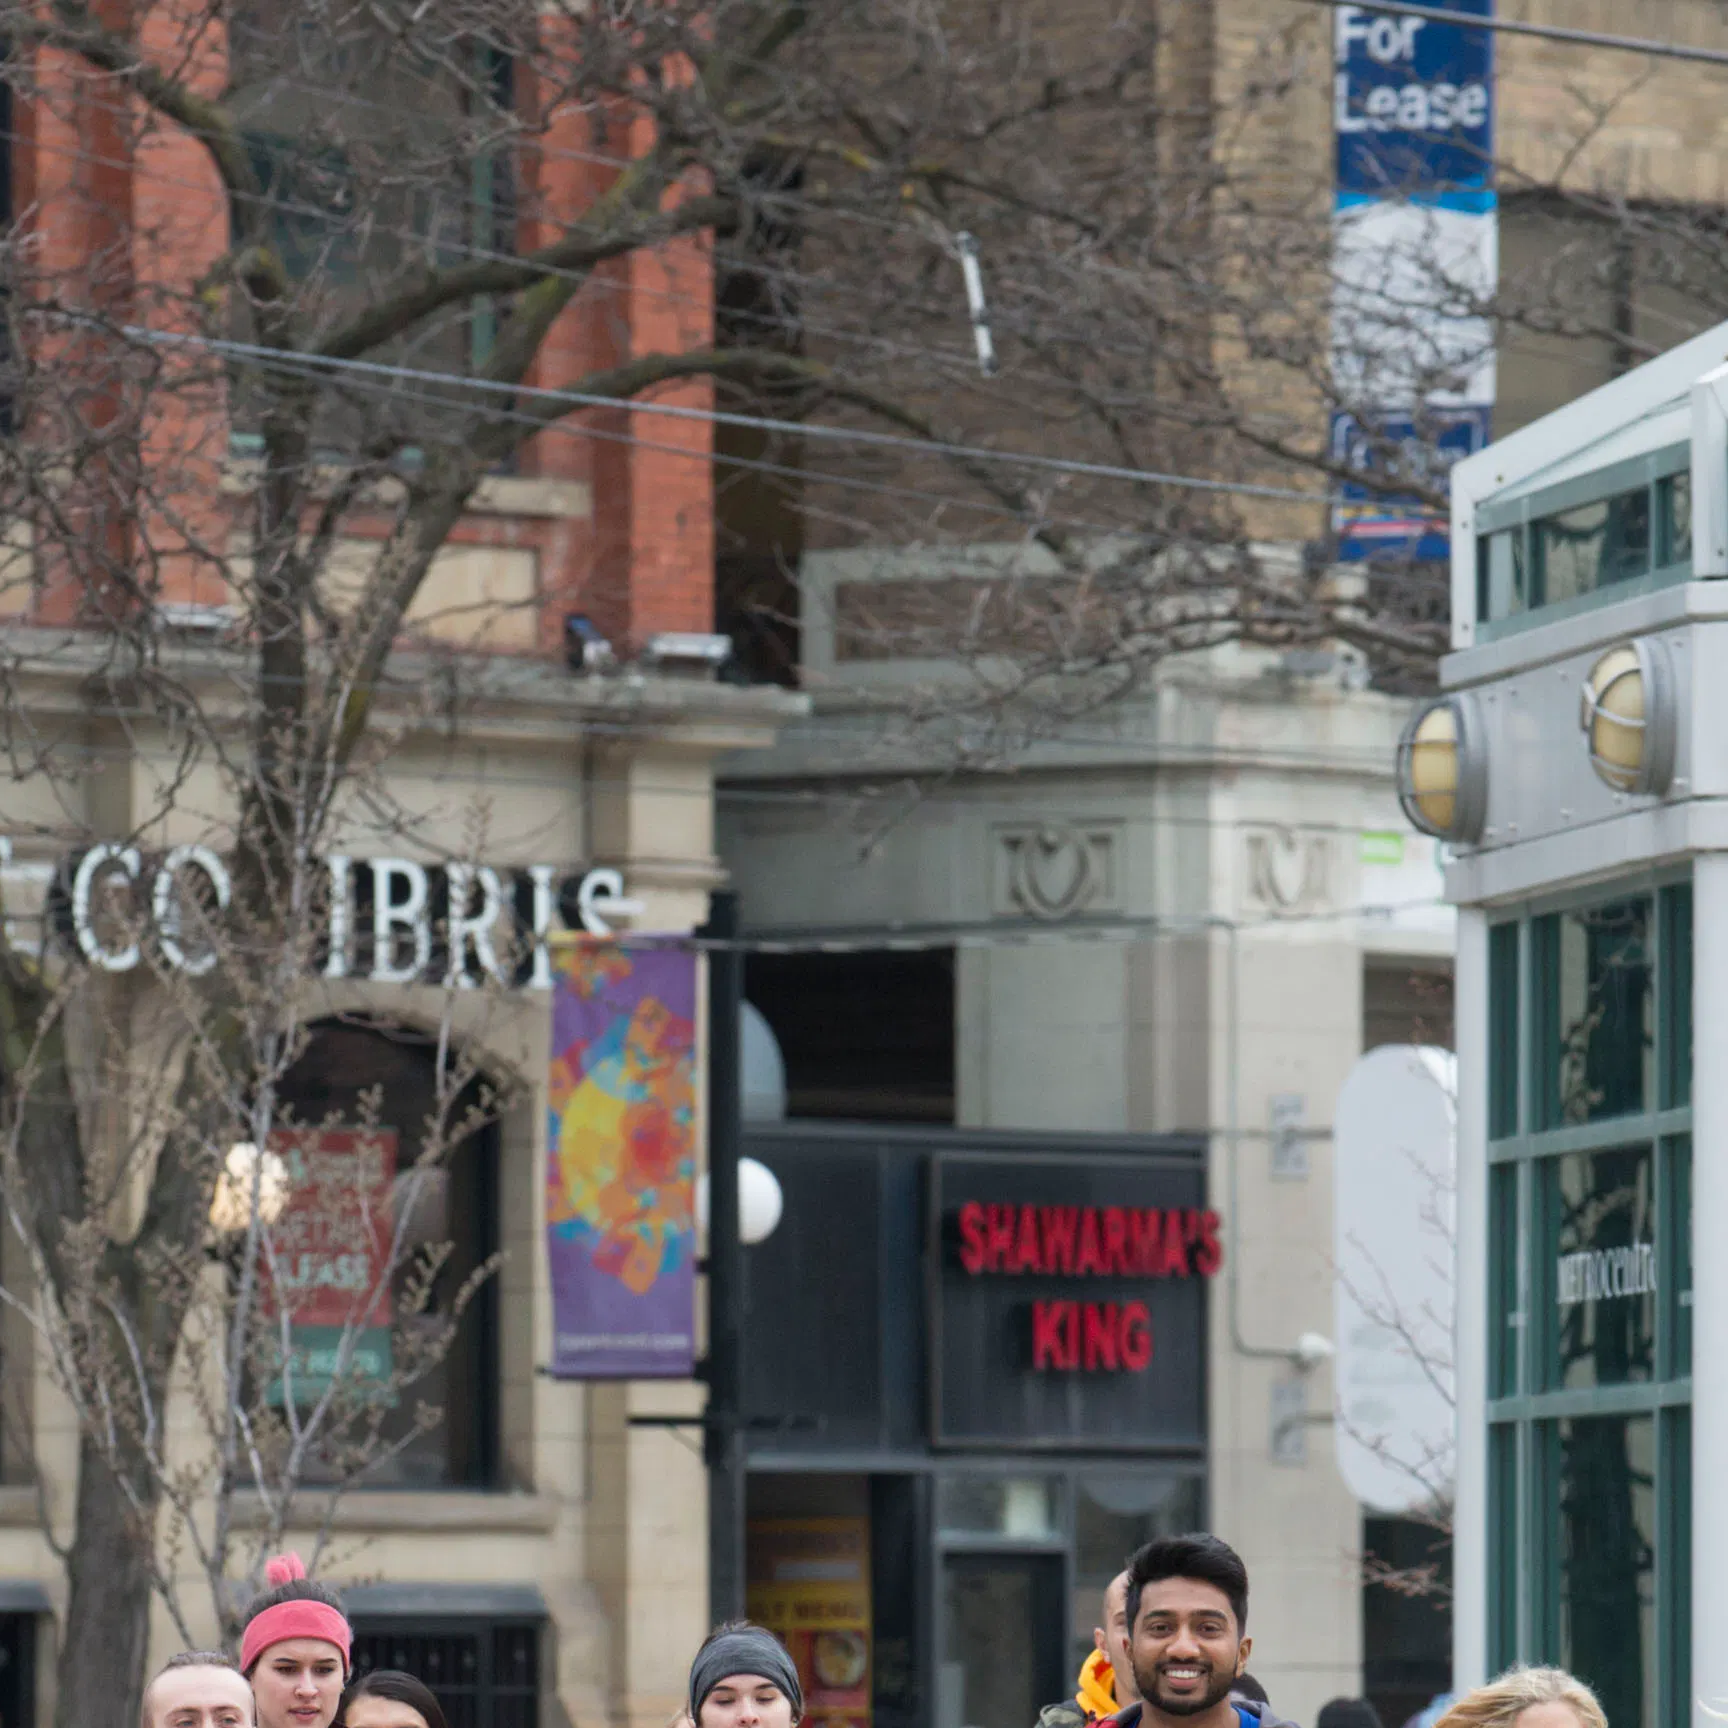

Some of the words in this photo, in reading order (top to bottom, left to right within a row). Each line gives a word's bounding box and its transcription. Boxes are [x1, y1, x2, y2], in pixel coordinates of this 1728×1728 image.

[1334, 5, 1426, 64] For
[1334, 71, 1487, 132] Lease
[958, 1200, 1222, 1279] SHAWARMA'S
[1032, 1299, 1153, 1372] KING
